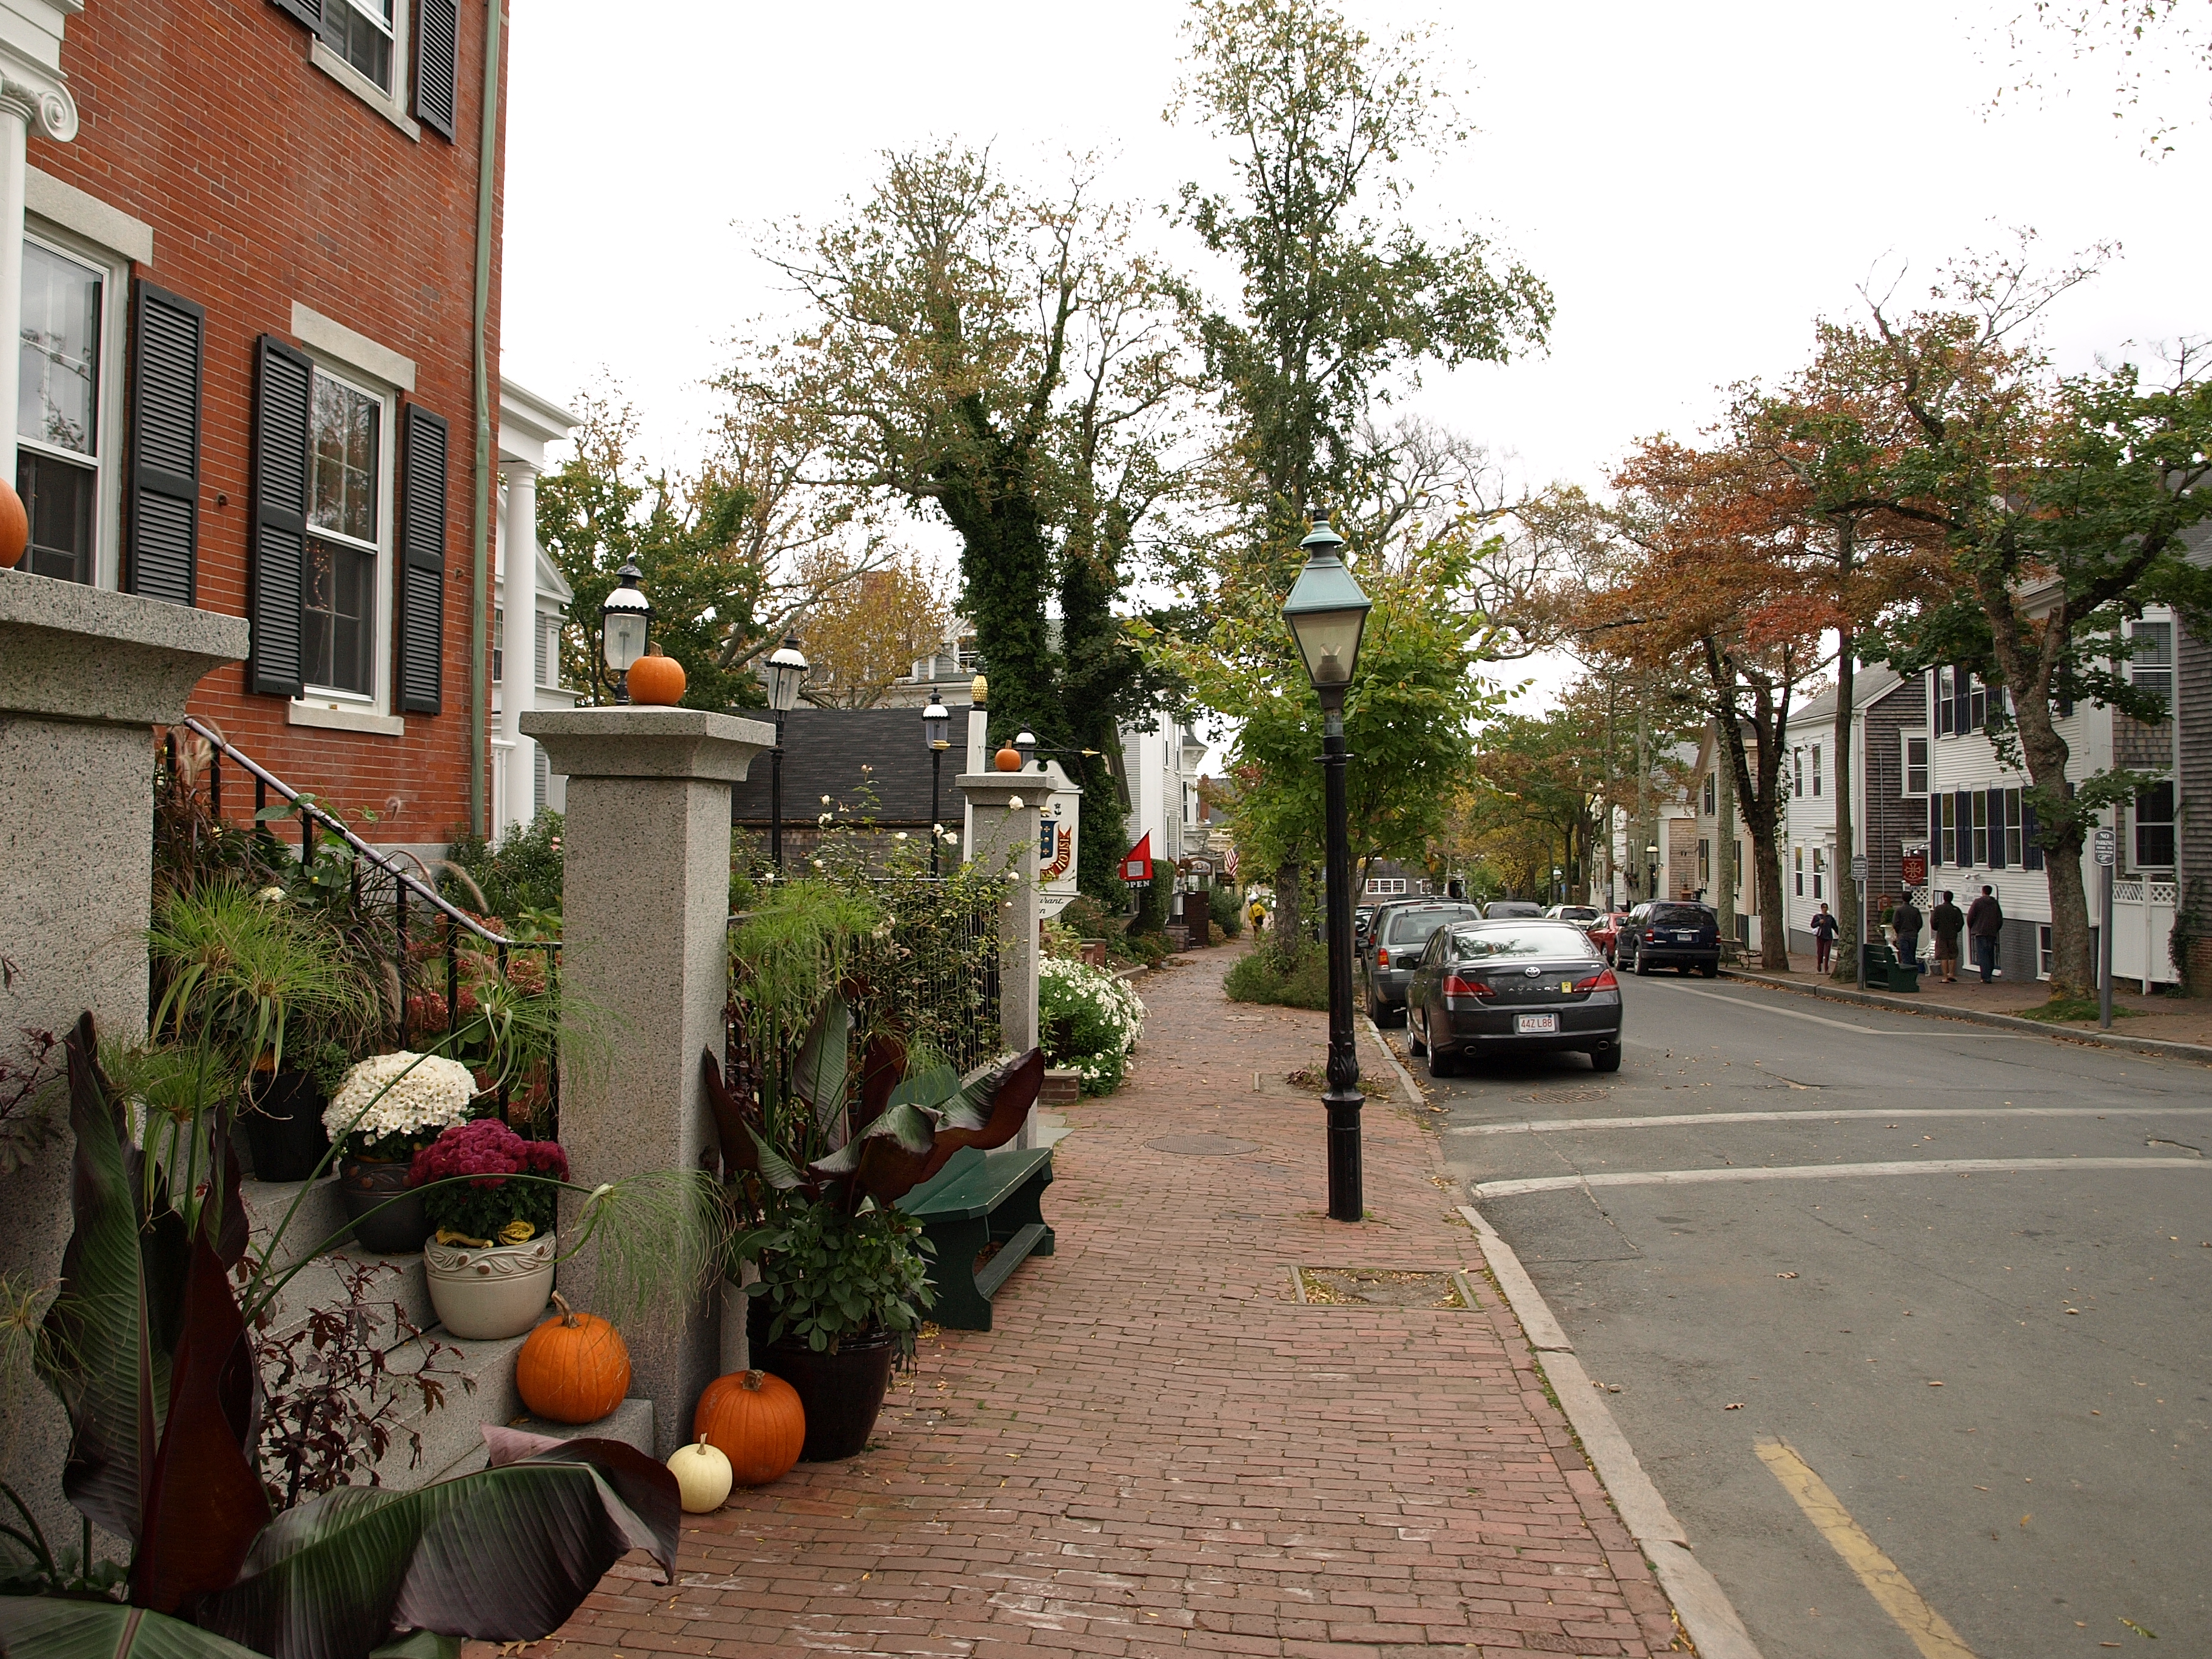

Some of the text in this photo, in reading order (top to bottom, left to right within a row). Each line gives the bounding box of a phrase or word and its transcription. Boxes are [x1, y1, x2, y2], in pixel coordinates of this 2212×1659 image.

[1124, 880, 1150, 888] OPEN
[1521, 1018, 1553, 1028] 44Z L88
